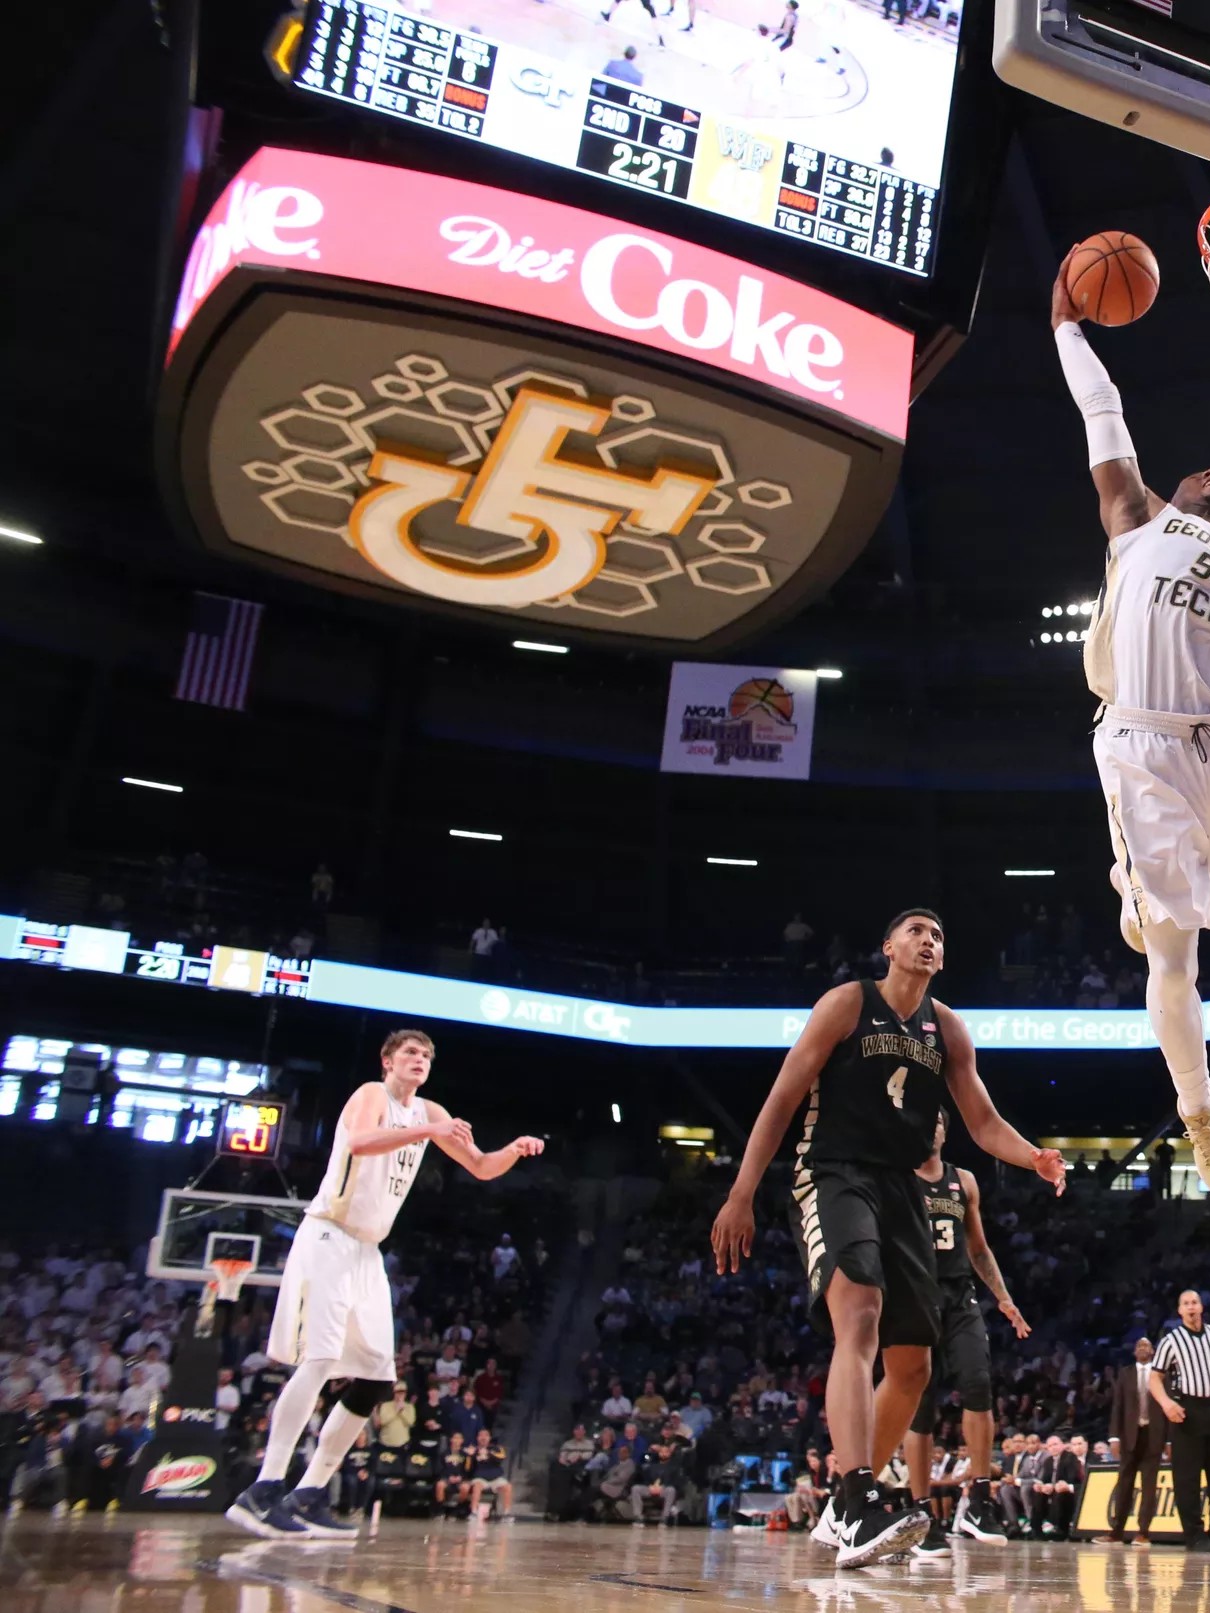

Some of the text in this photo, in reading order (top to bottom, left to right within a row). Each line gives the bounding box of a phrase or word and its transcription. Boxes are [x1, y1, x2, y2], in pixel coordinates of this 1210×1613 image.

[589, 104, 687, 152] 2ND 20
[607, 142, 678, 194] 2:21
[821, 202, 839, 219] FT
[439, 215, 845, 395] Diet Coke
[684, 704, 727, 718] NCAA
[713, 741, 783, 765] Four
[512, 1000, 569, 1025] AT&T
[977, 1016, 1007, 1041] of
[1009, 1018, 1056, 1041] the
[1072, 1018, 1157, 1046] Georgi
[861, 1033, 943, 1076] WAKE FOREST
[886, 1065, 909, 1109] 4
[397, 1150, 416, 1174] 44
